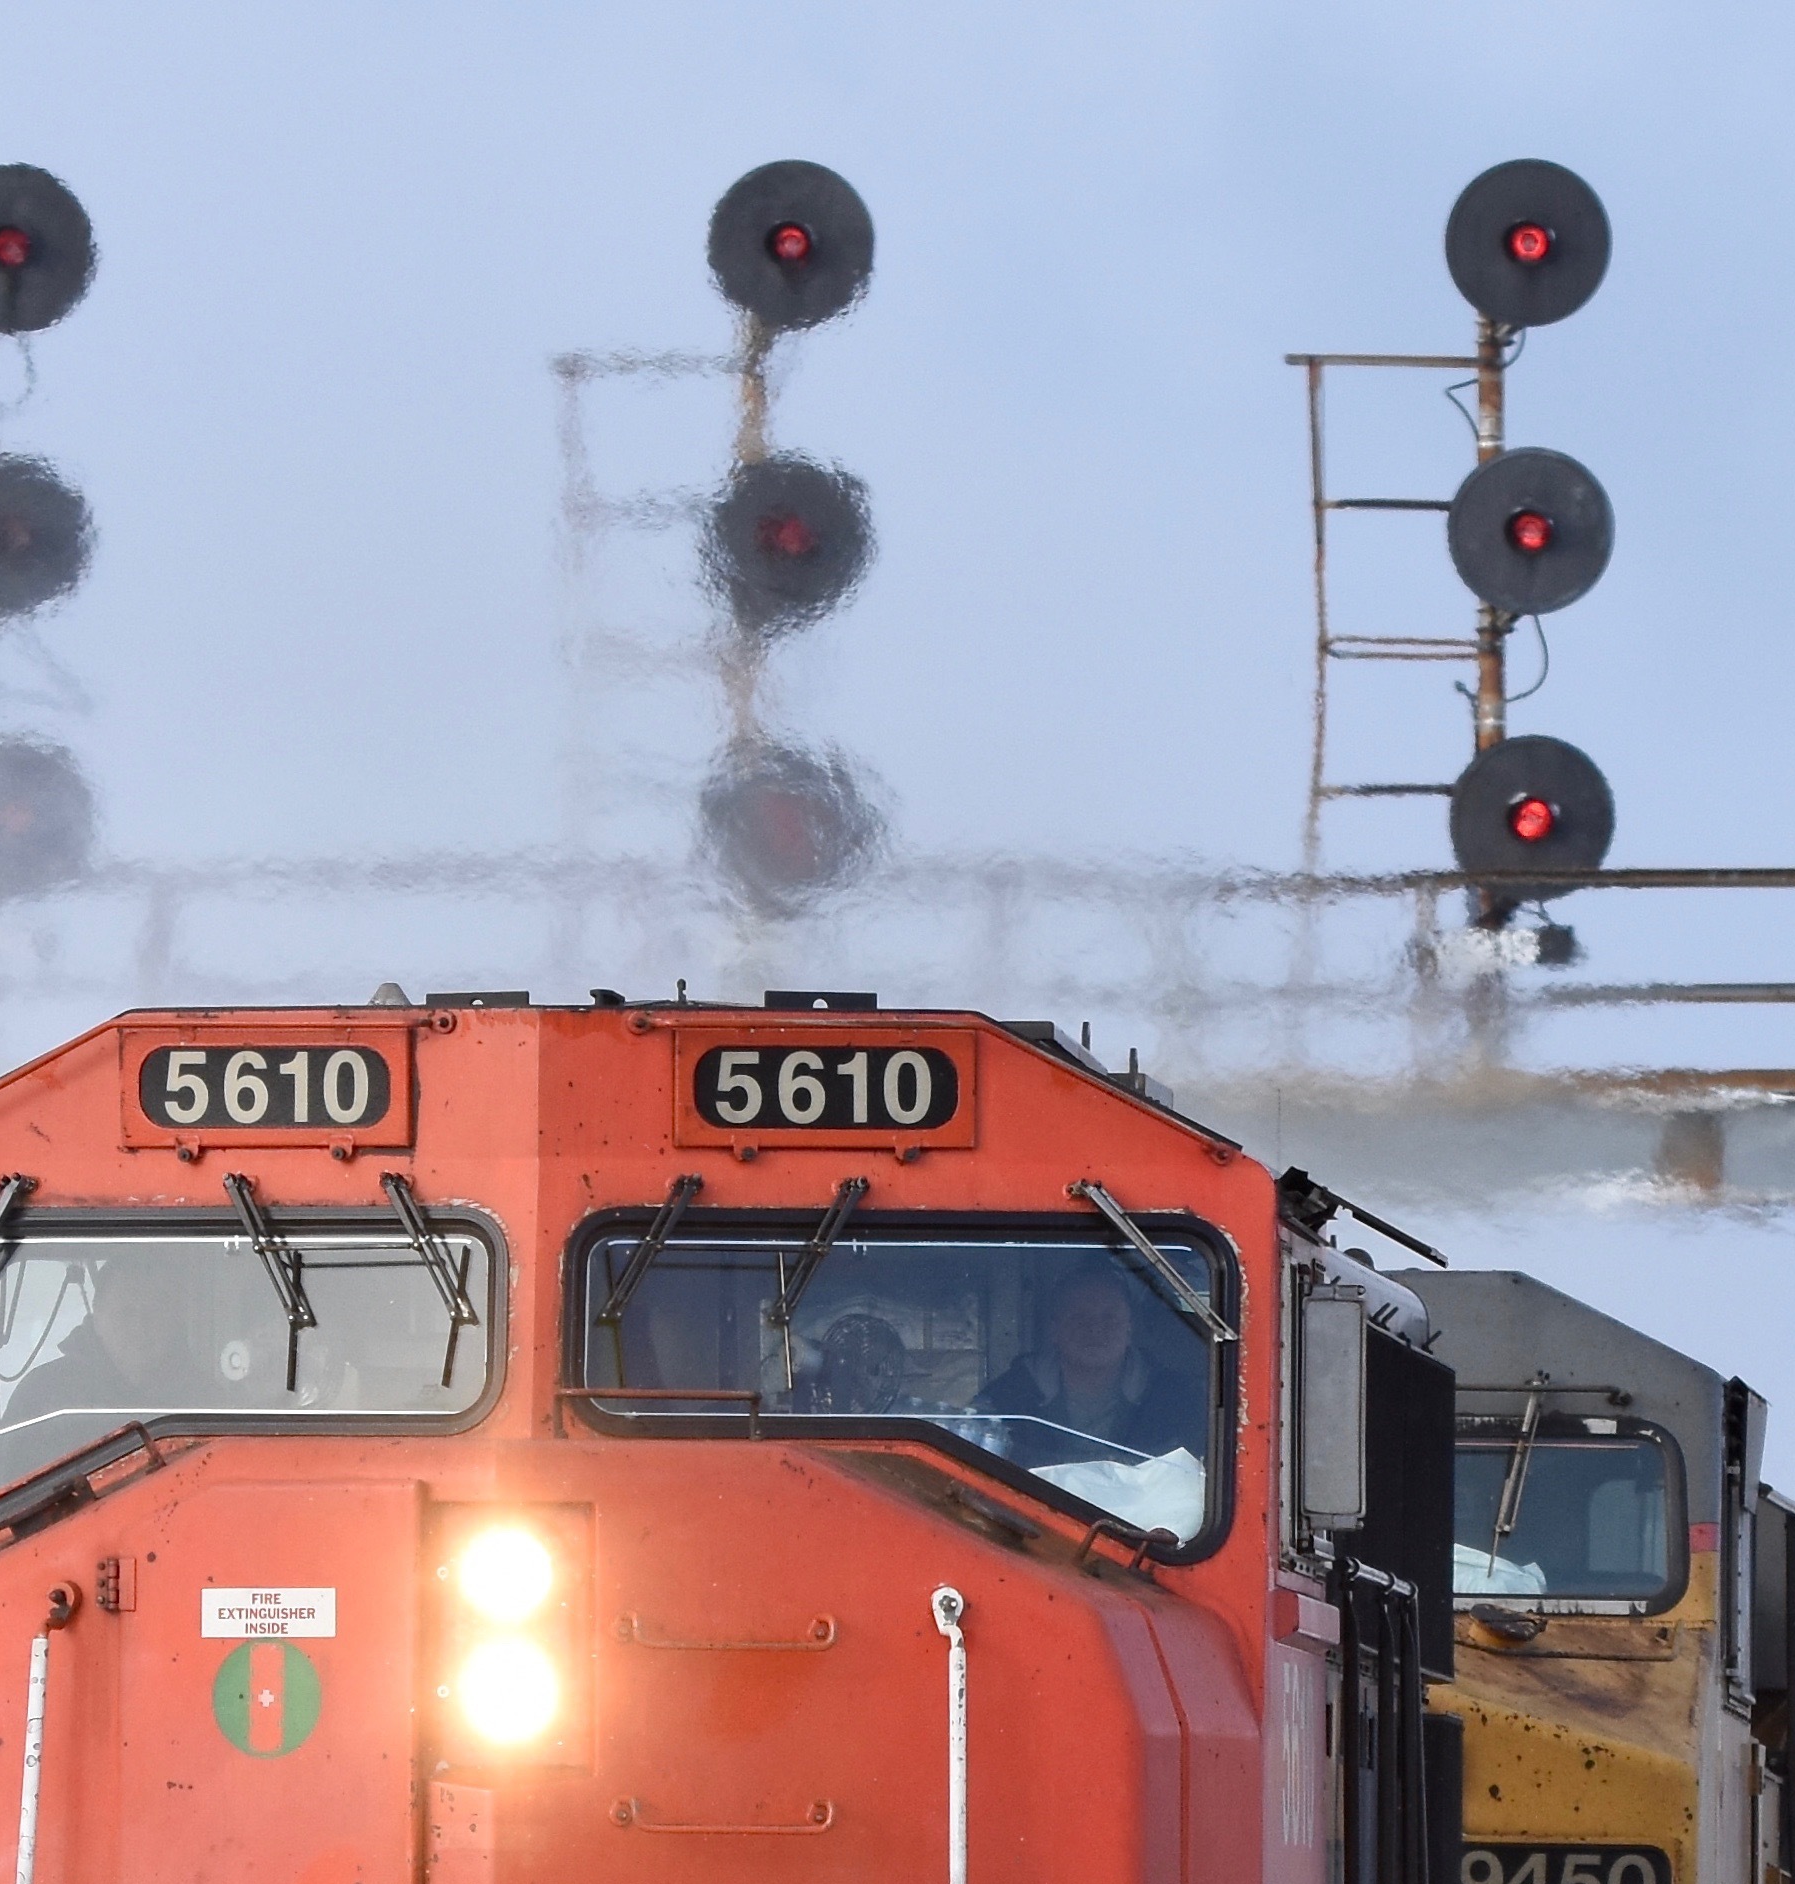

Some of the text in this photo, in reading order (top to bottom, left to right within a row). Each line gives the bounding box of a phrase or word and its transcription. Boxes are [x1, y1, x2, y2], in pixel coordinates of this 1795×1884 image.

[164, 1050, 368, 1124] 5610
[715, 1050, 932, 1124] 5610
[251, 1593, 282, 1605] FIRE
[218, 1607, 316, 1620] EXTINGUISHER
[245, 1622, 289, 1634] INSIDE
